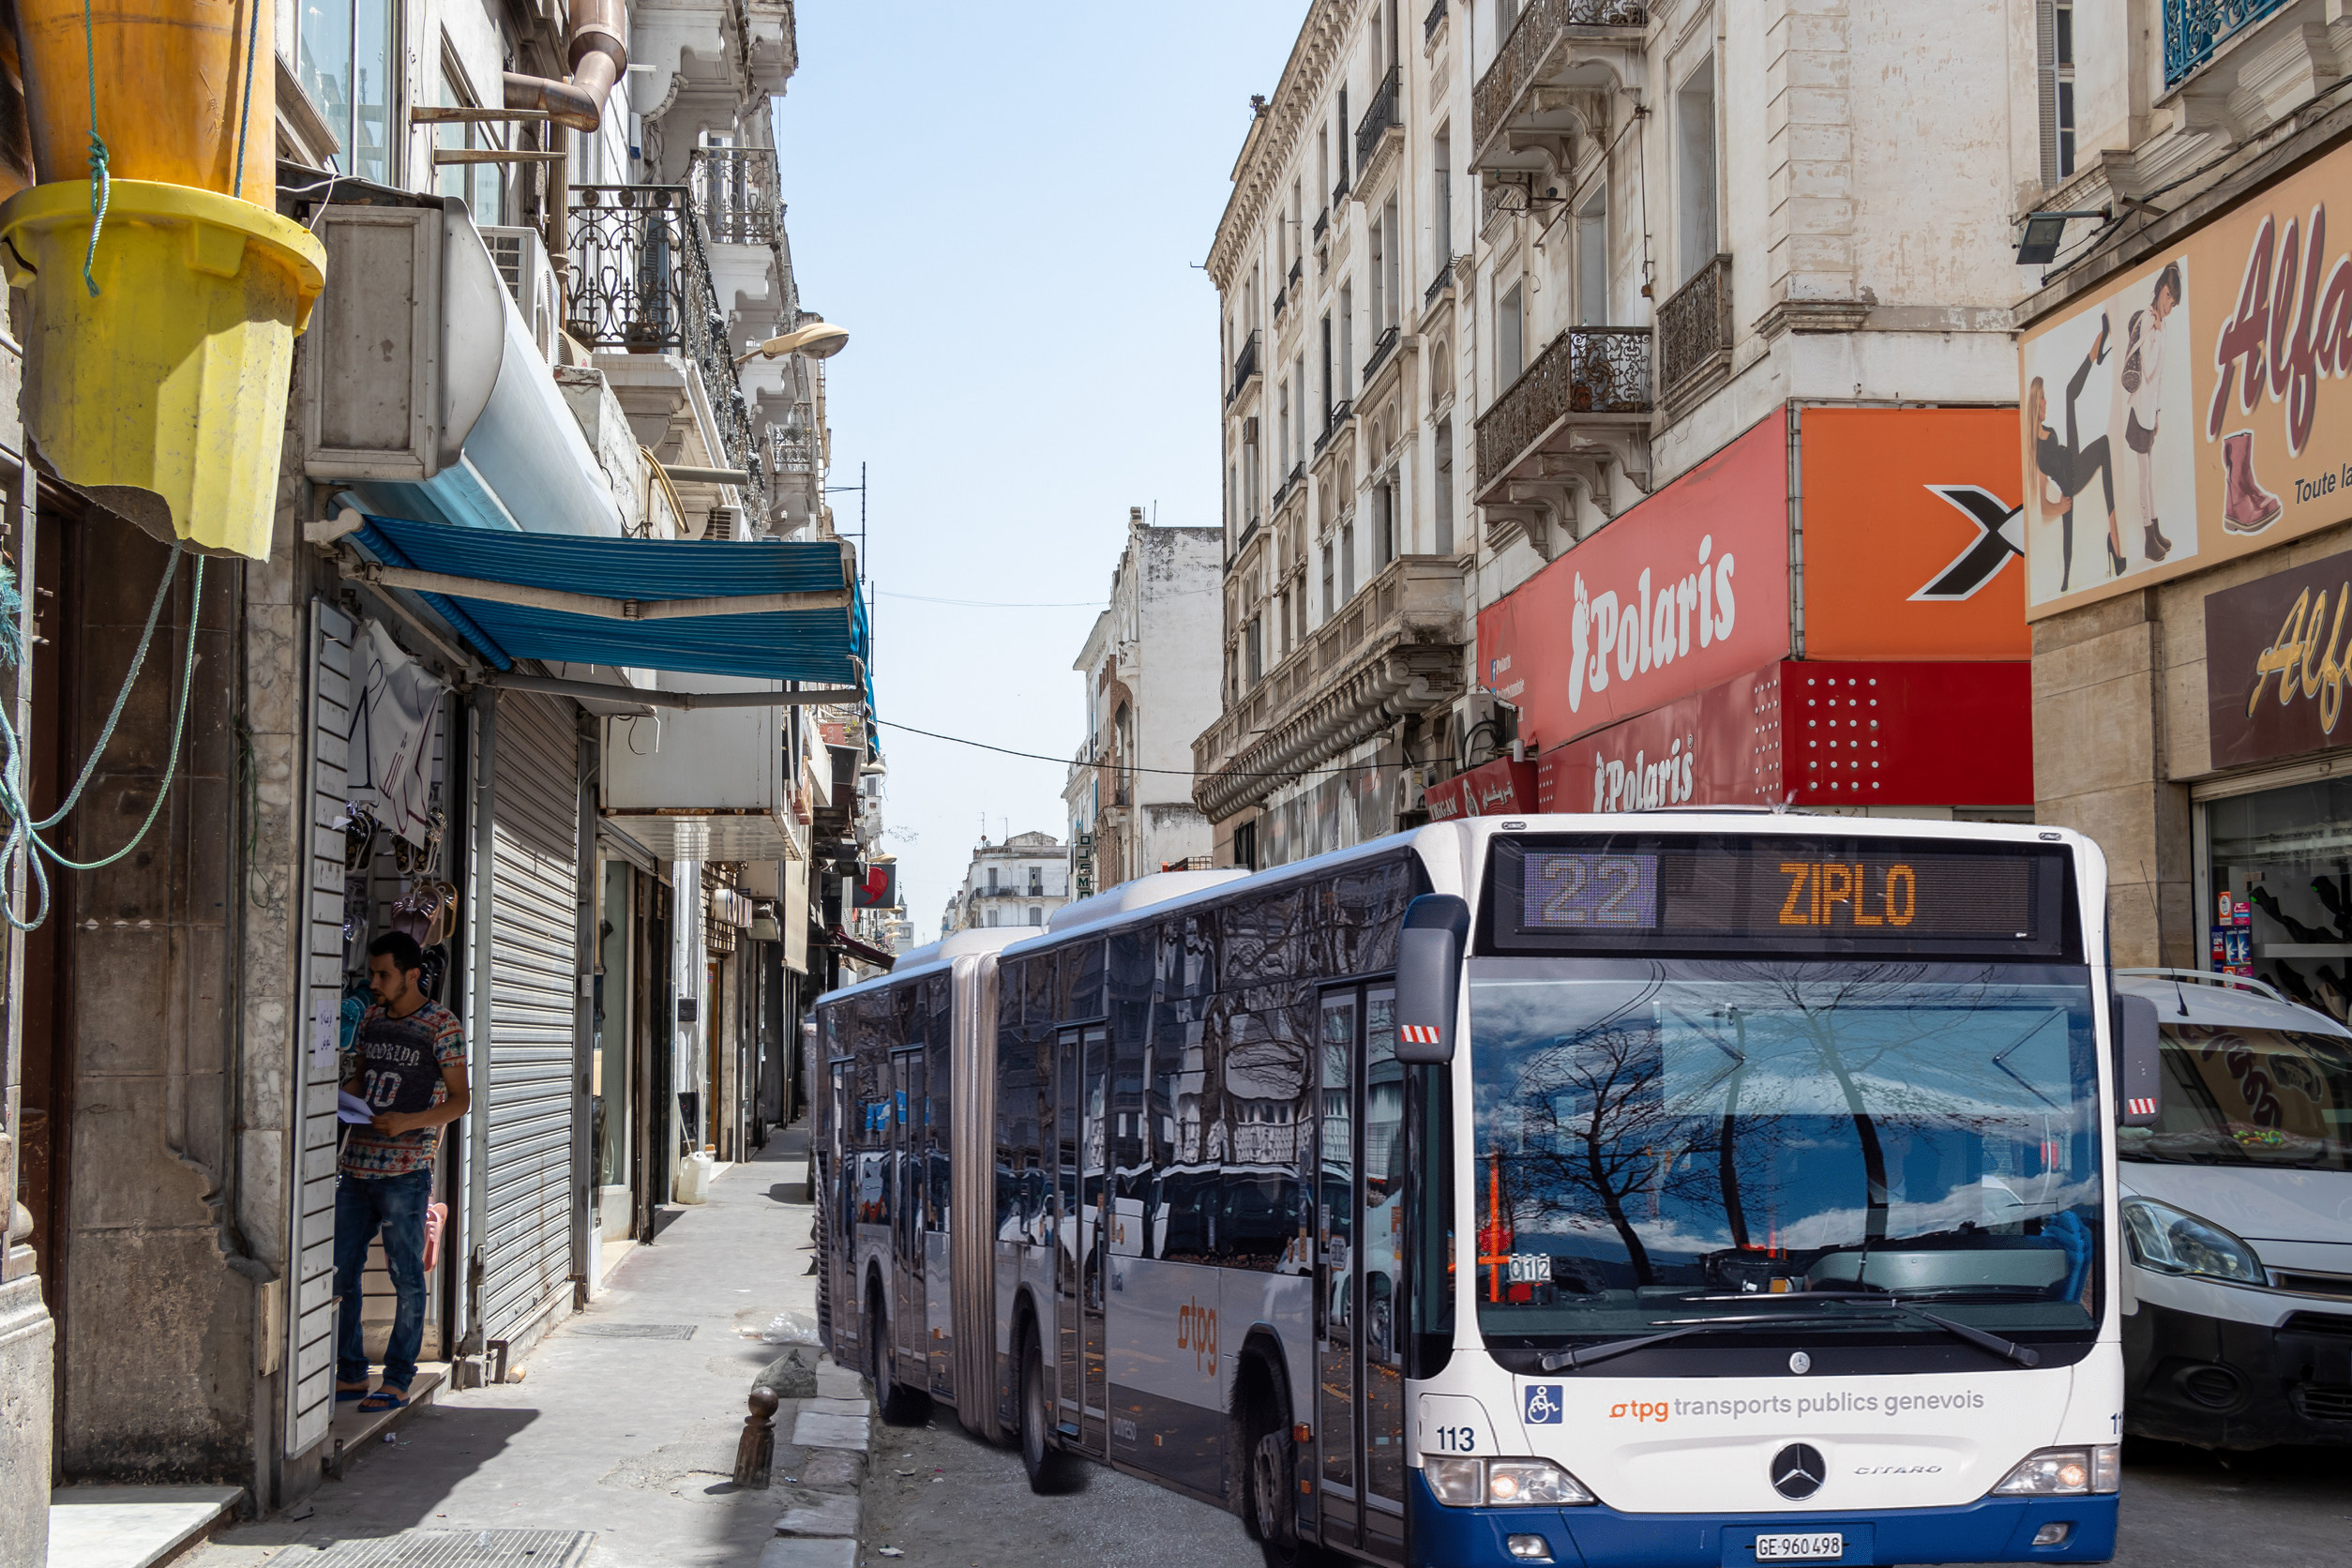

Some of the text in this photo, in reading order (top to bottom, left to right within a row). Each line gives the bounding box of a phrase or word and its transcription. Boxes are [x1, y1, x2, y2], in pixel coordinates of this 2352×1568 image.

[2295, 472, 2336, 505] Toute
[1589, 534, 1735, 693] Polaris
[2246, 580, 2352, 735] Alf
[1604, 738, 1694, 814] Polaris
[1543, 857, 1916, 926] 22 ZIPLO
[365, 1041, 421, 1067] ROOKLYN
[1510, 1259, 1550, 1279] 012
[1674, 1395, 1792, 1420] transports
[1797, 1392, 1878, 1418] publics
[1884, 1390, 1984, 1416] genevois
[1437, 1425, 1474, 1452] 113
[1854, 1465, 1942, 1475] CITARO
